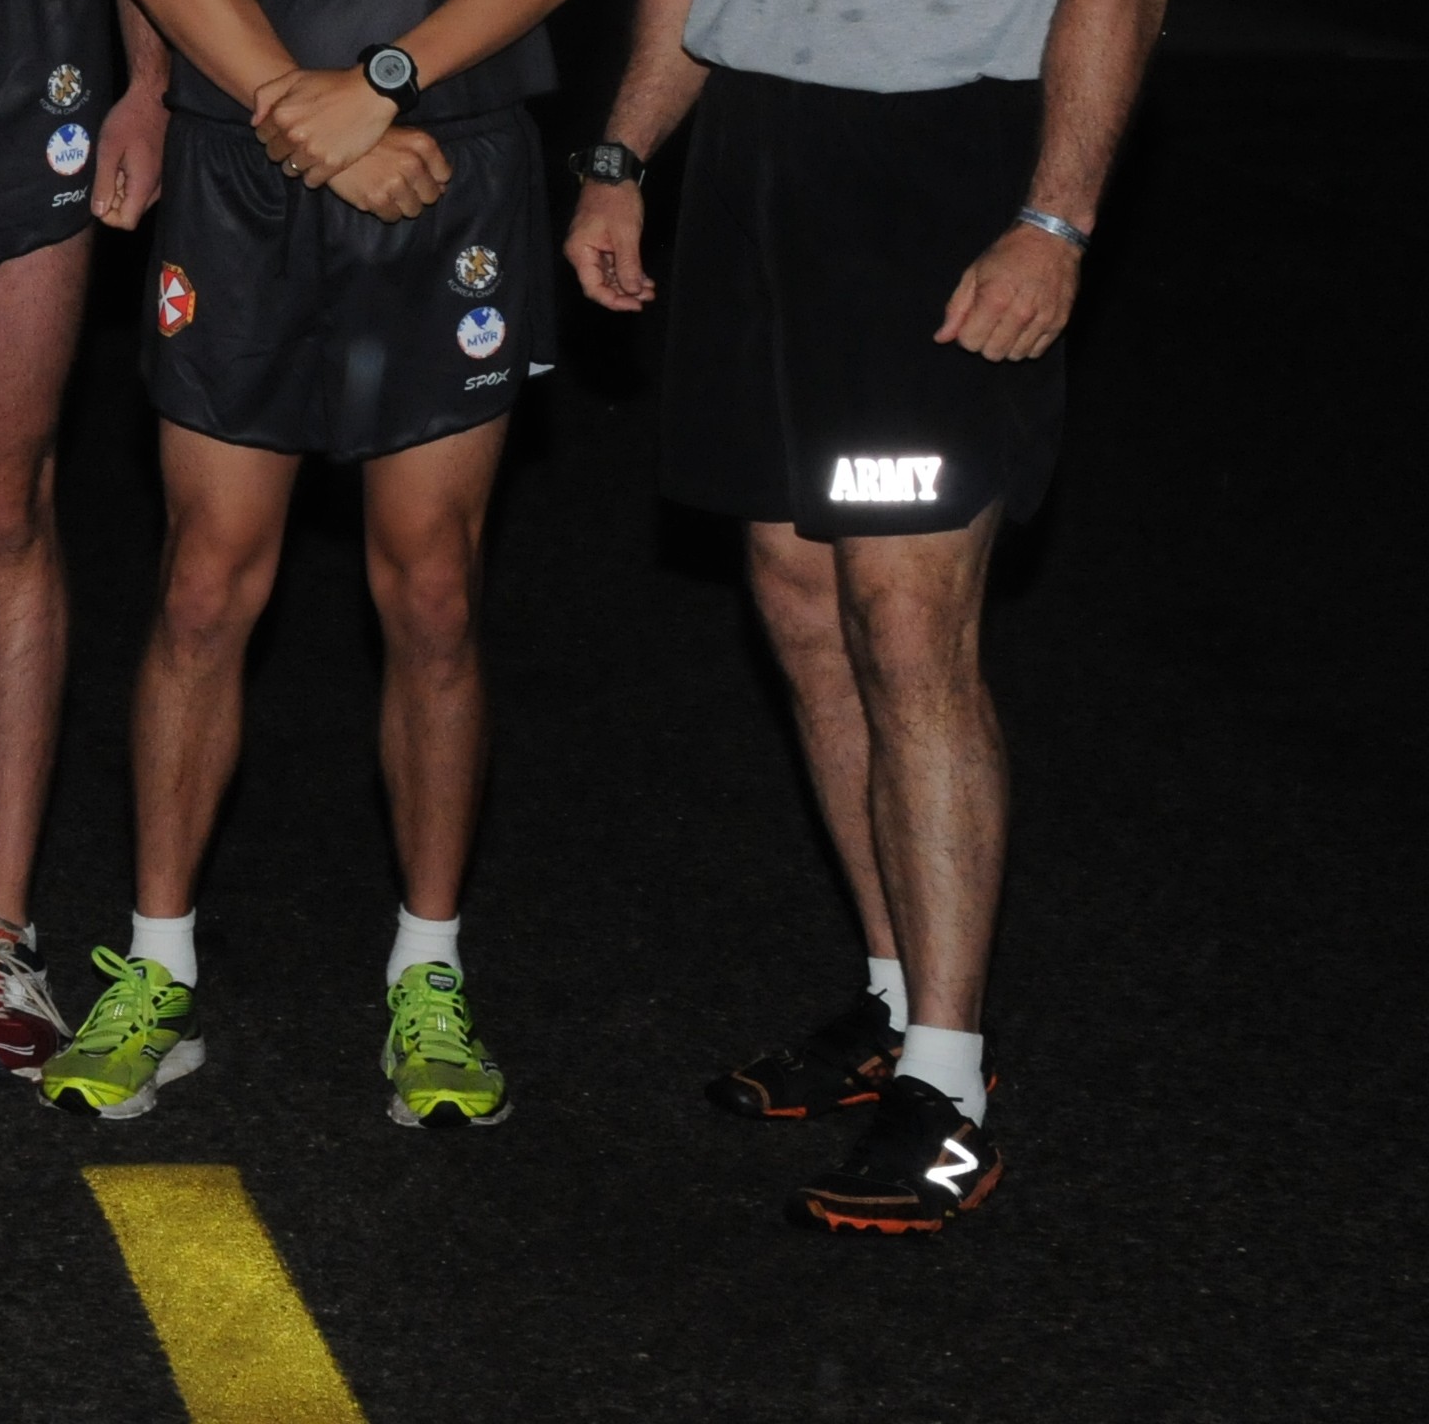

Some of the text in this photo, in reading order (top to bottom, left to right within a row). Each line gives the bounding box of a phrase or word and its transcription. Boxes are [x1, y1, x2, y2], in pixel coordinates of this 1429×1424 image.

[55, 149, 84, 164] MWR
[51, 185, 89, 208] SPOX
[467, 332, 498, 347] MWR
[464, 368, 511, 391] SPOX
[829, 457, 942, 502] ARMY
